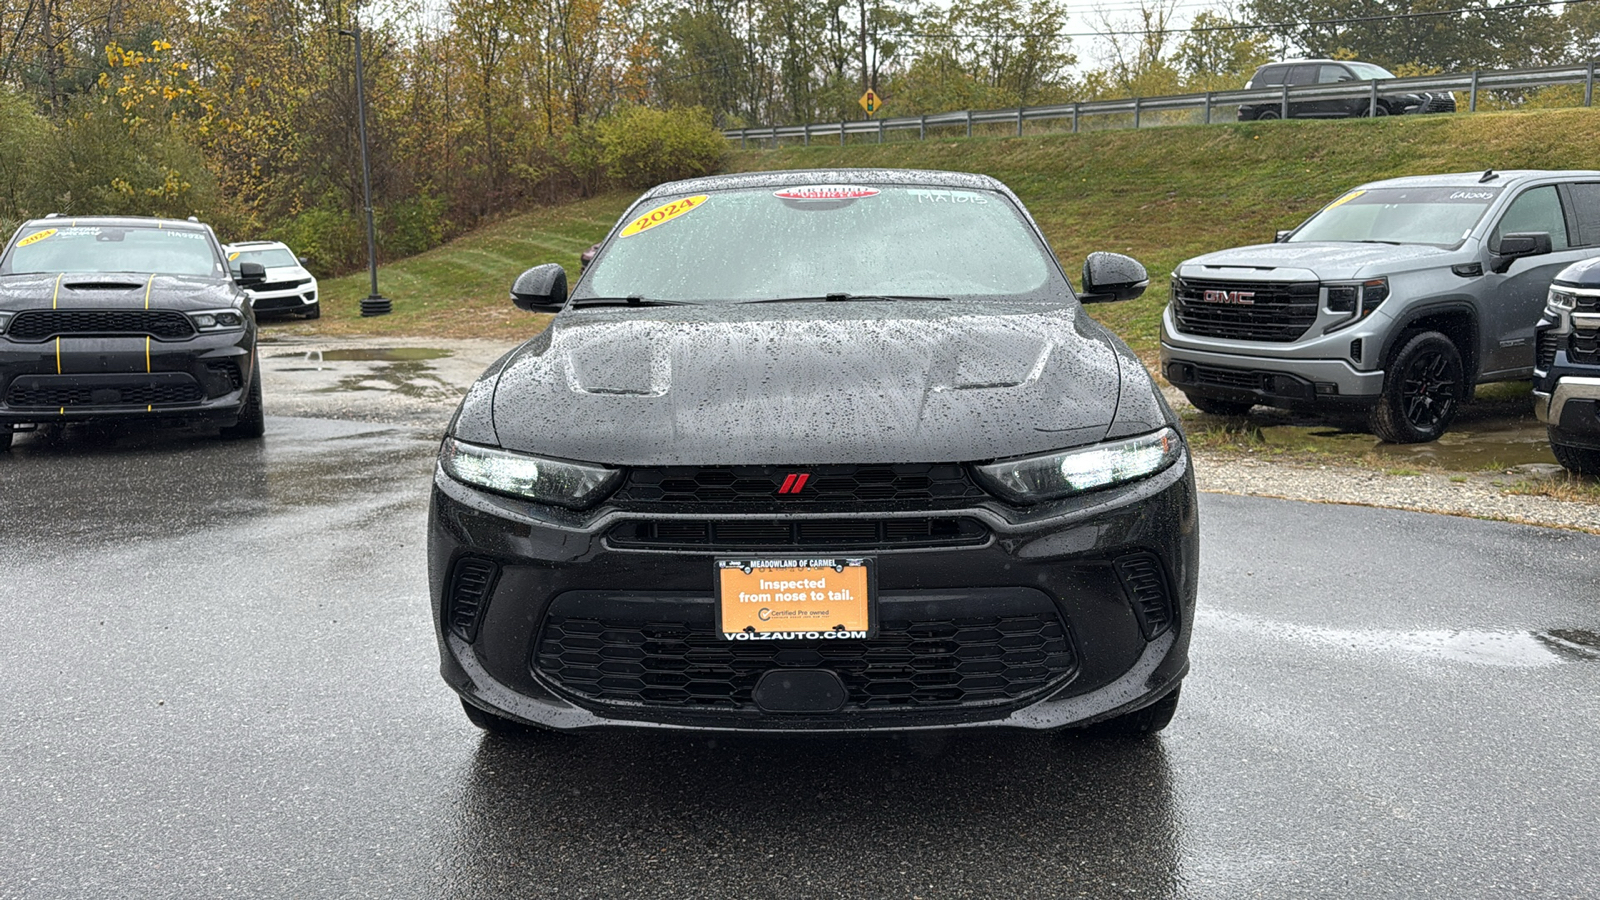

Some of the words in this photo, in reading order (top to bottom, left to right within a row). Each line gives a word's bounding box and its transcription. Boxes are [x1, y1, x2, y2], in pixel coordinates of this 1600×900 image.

[636, 199, 695, 229] 2024
[1204, 289, 1256, 304] GMC
[750, 560, 798, 568] MEADOWLAND
[799, 559, 808, 567] OF
[809, 559, 837, 567] CARMEL
[759, 578, 826, 591] Inspected
[739, 592, 772, 603] from
[775, 592, 807, 602] nose
[810, 590, 825, 601] to
[828, 589, 854, 601] tail.
[724, 631, 867, 641] VOLZAUTO.COM
